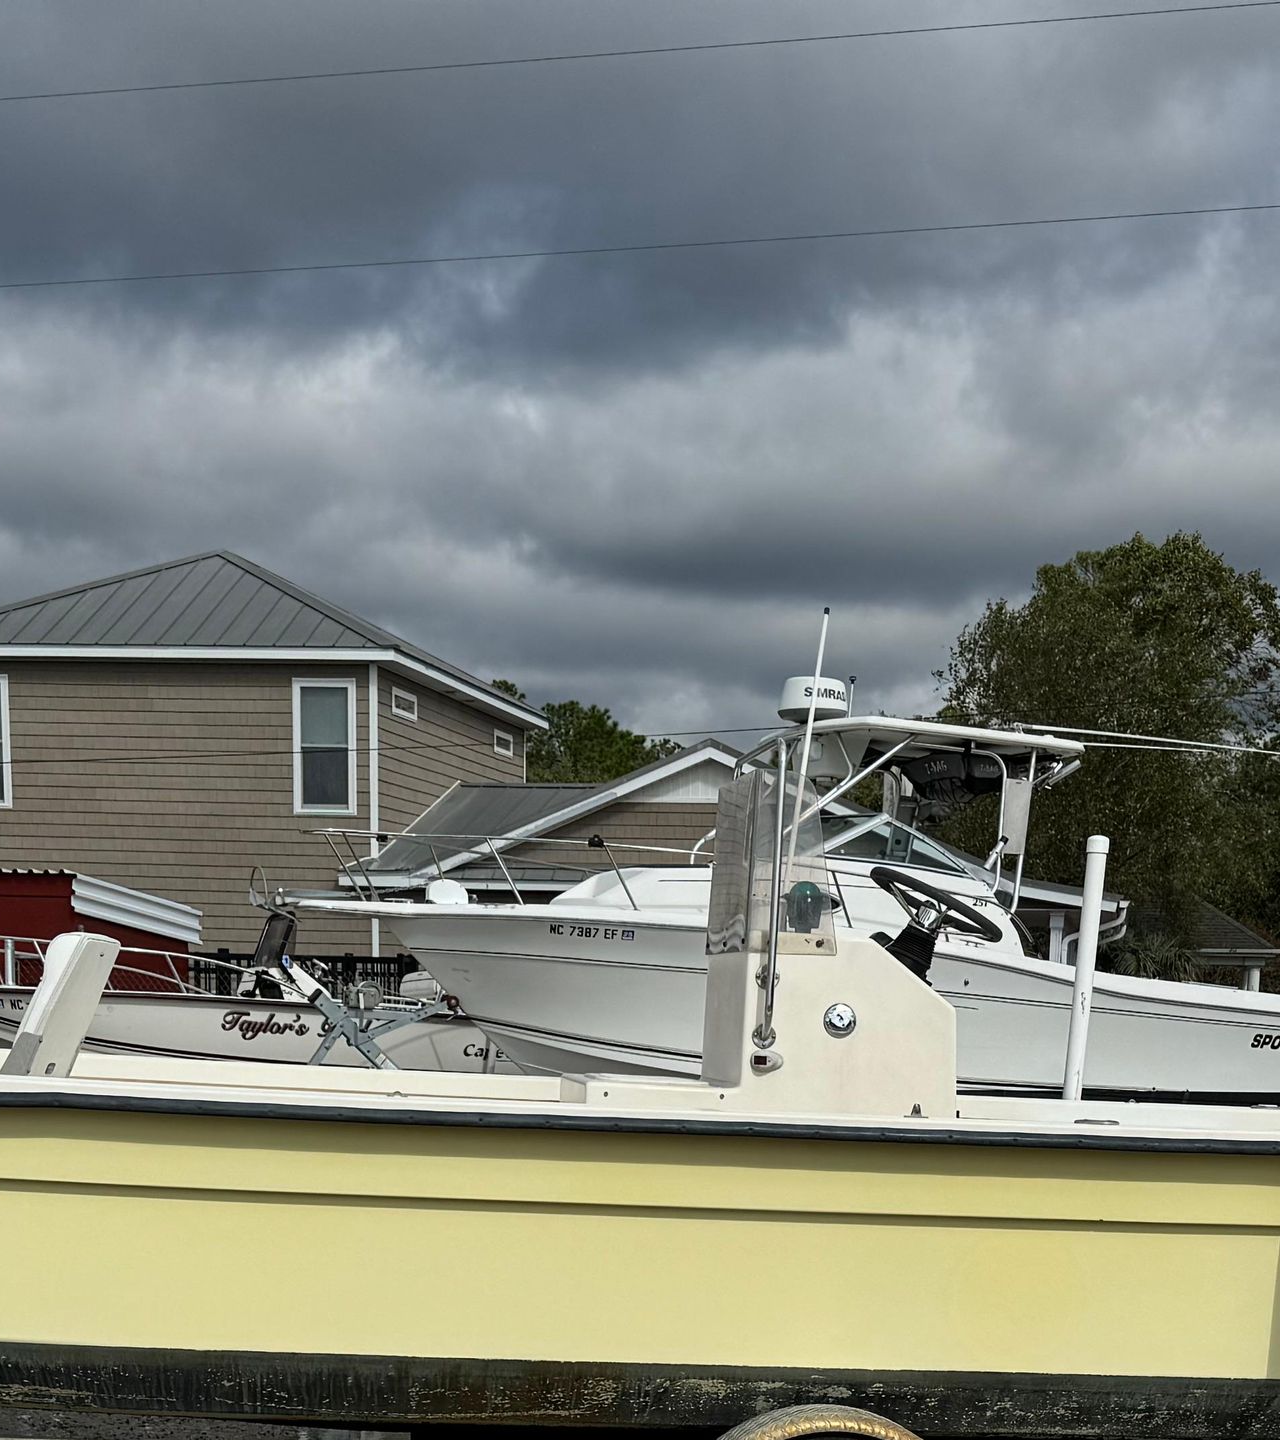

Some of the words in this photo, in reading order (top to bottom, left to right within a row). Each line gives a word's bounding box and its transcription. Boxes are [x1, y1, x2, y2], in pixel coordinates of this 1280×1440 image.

[549, 924, 564, 935] NC
[569, 925, 600, 938] 7387
[604, 928, 619, 940] EF
[10, 999, 24, 1010] NC
[221, 1010, 310, 1040] Taylor's
